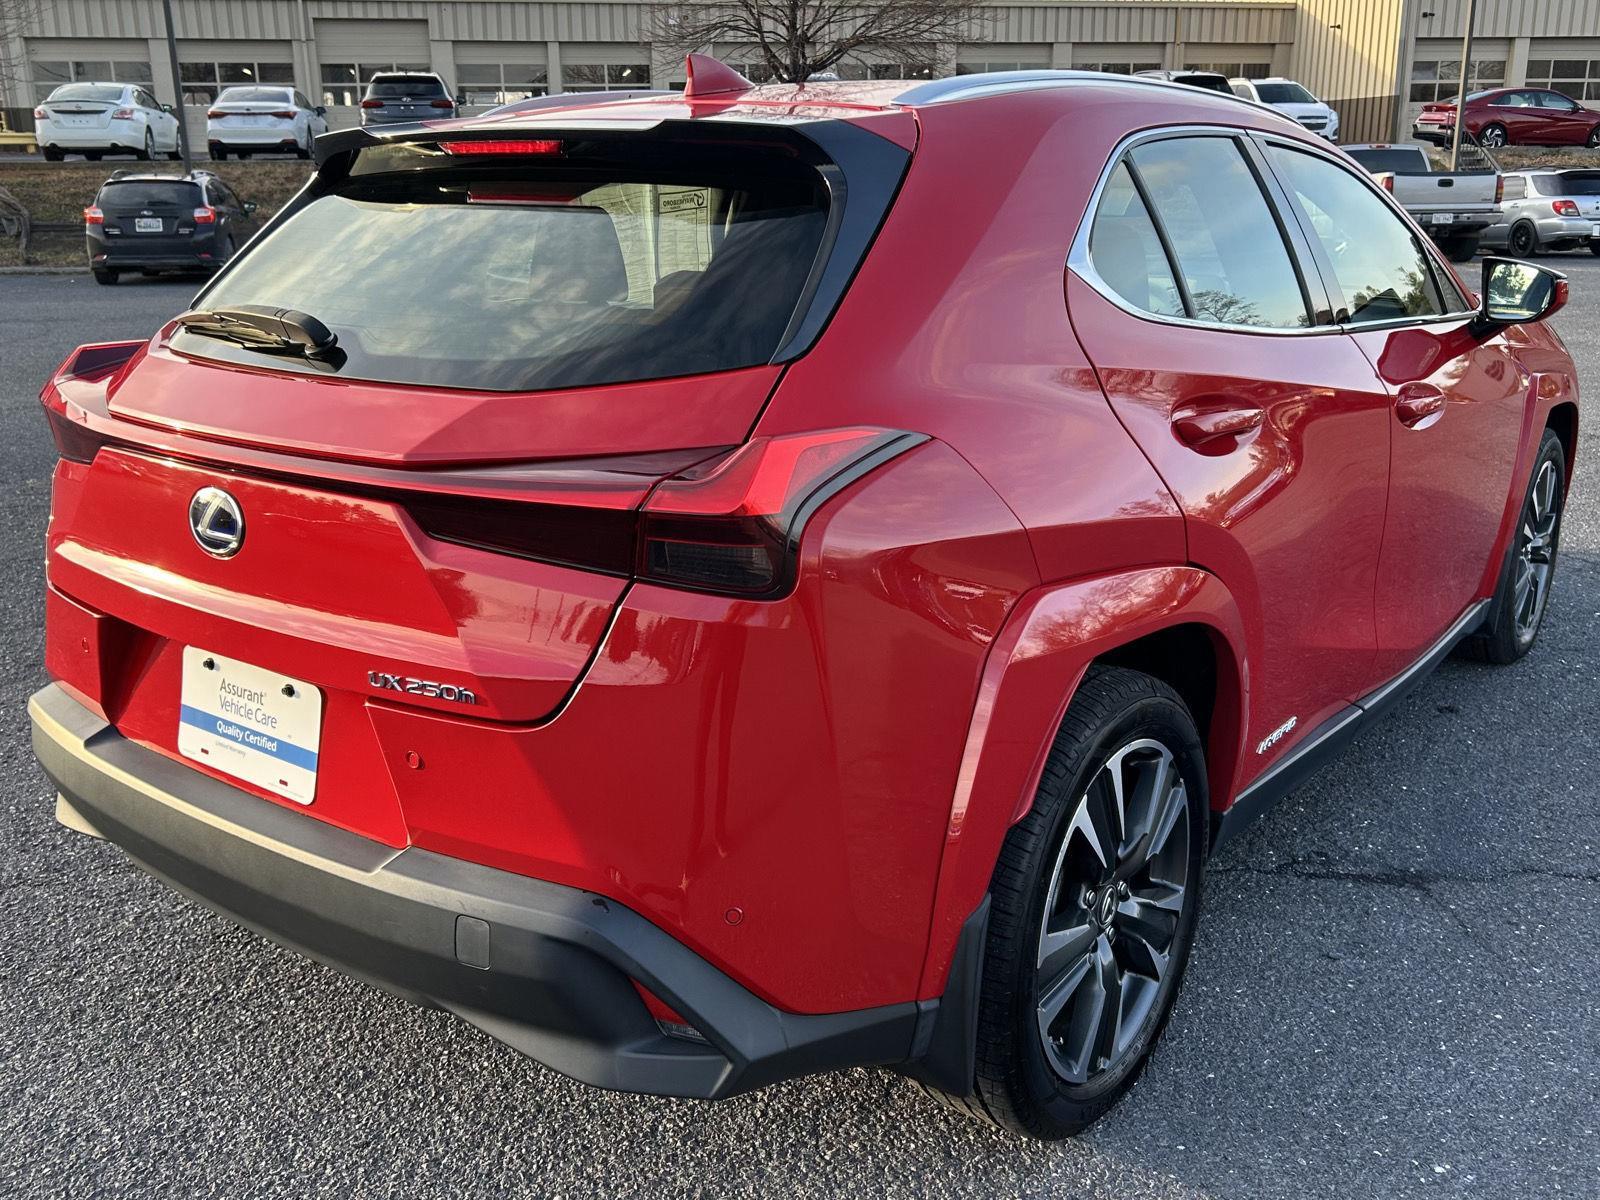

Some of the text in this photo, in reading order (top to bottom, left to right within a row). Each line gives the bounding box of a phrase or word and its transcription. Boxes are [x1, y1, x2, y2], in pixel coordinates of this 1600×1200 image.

[219, 678, 265, 706] Assurant
[367, 670, 476, 705] UX 250h
[219, 695, 277, 729] Vehicle Care
[216, 720, 277, 752] Quality Certified
